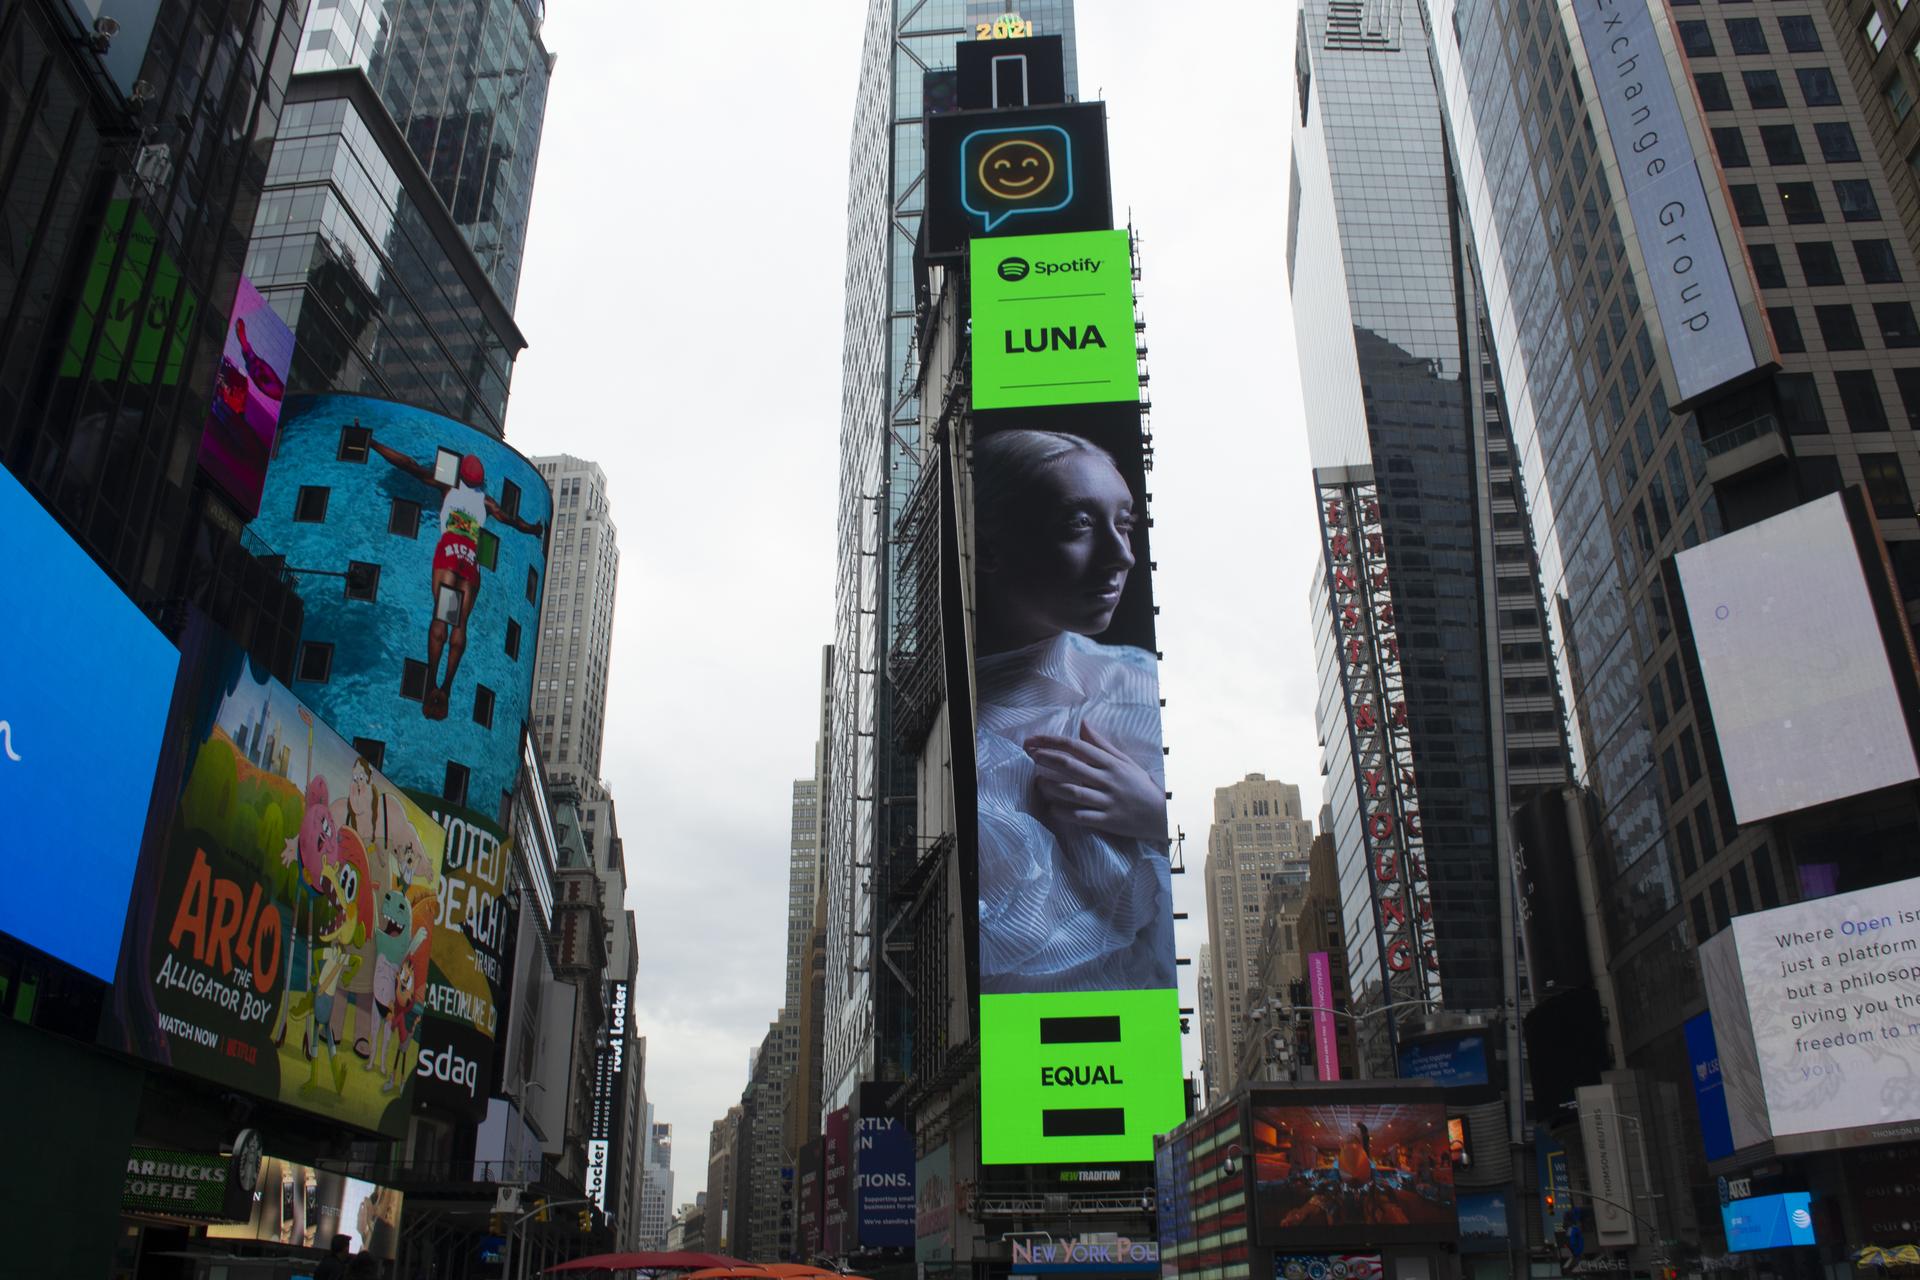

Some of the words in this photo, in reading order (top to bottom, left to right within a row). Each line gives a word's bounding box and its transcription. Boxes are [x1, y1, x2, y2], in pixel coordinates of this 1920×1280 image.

[976, 20, 1033, 41] 2021
[1035, 258, 1102, 276] Spotify
[1659, 201, 1709, 331] Group
[1005, 325, 1107, 354] LUNA
[168, 847, 282, 993] ARLO
[1775, 928, 1834, 948] Where
[1840, 916, 1892, 936] Open
[1781, 957, 1815, 978] just
[1821, 955, 1831, 967] a
[1838, 938, 1917, 966] platform
[156, 953, 240, 1012] ALLIGATOR
[240, 991, 272, 1023] BOY
[233, 967, 253, 989] THE
[1786, 983, 1816, 1000] but
[1823, 981, 1833, 994] a
[424, 983, 485, 1026] AFEONLINE
[609, 983, 627, 1035] Locker
[1791, 1007, 1847, 1029] giving
[1853, 1000, 1889, 1019] you
[157, 1011, 193, 1041] WATCH
[194, 1026, 219, 1049] NOW
[1796, 1030, 1874, 1052] freedom
[1880, 1026, 1900, 1040] to
[417, 1044, 478, 1098] sdaq
[1041, 1065, 1124, 1087] EQUAL
[127, 1159, 226, 1184] ARBUCKS
[1729, 1178, 1751, 1200] AT&T
[1012, 1238, 1057, 1264] NEW
[1059, 1237, 1112, 1264] YORK
